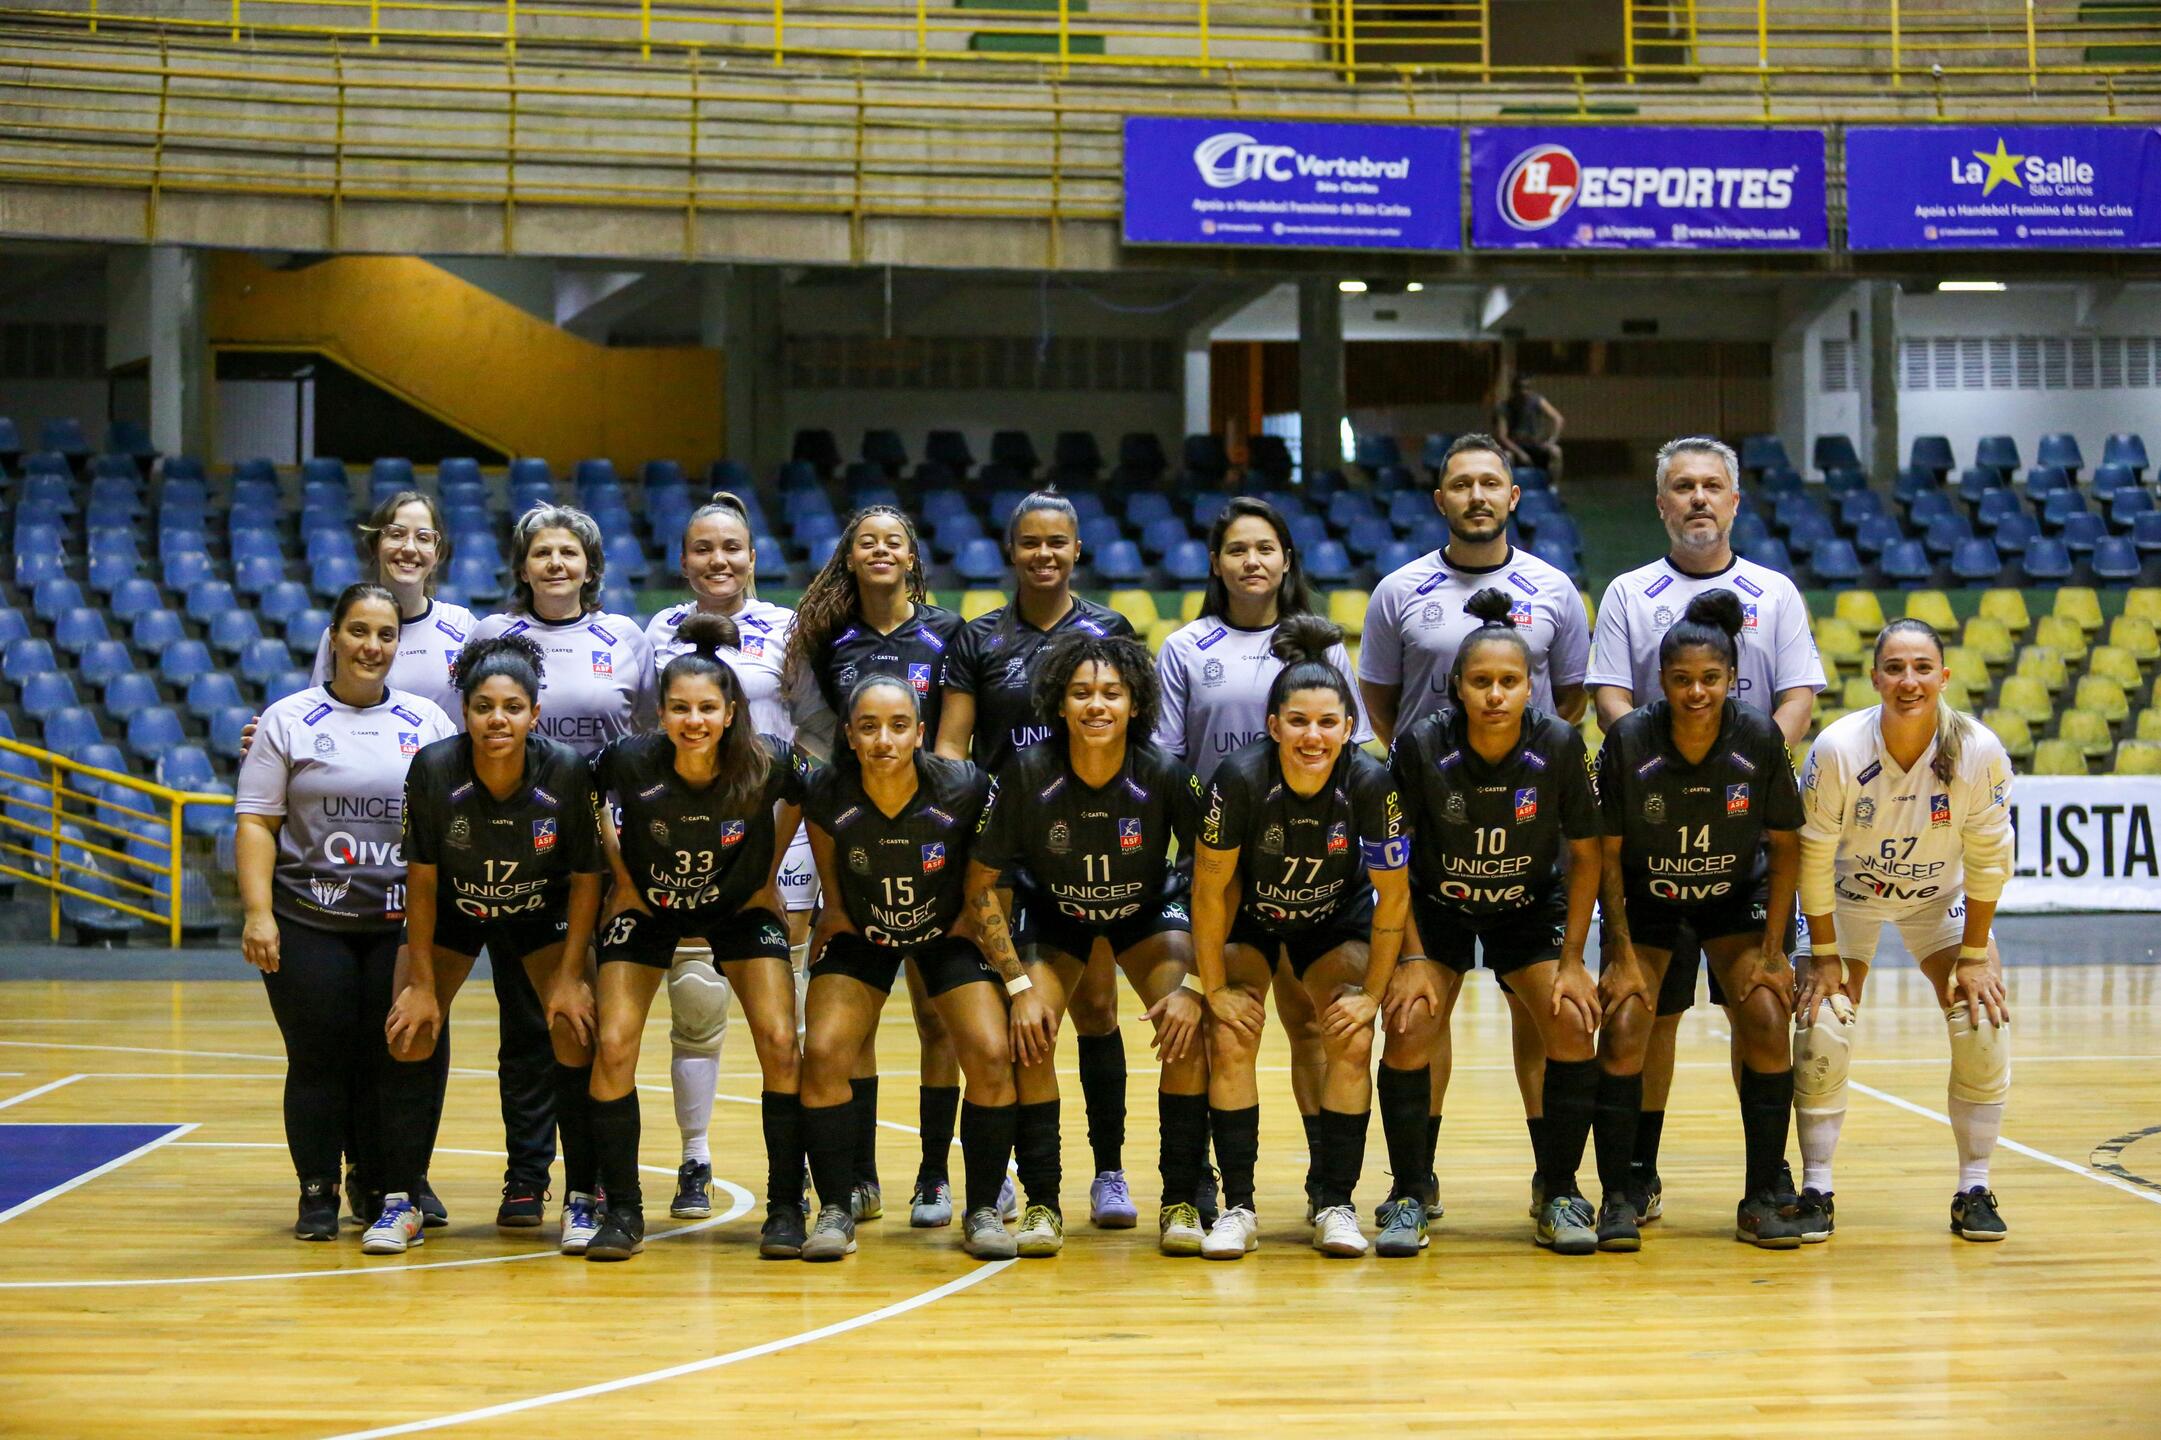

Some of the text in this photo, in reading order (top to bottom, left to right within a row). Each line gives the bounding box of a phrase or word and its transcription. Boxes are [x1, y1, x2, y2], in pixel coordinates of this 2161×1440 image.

[1296, 154, 1410, 180] Vertebral
[1951, 155, 2094, 184] La Salle
[1340, 182, 1380, 195] Carlos
[1576, 166, 1795, 209] ESPORTES
[2029, 183, 2094, 197] São Carlos
[1377, 203, 1412, 217] Carlos
[1915, 204, 1947, 218] Apoia
[1958, 204, 2010, 216] Handebol
[2011, 204, 2060, 217] Feminino
[2062, 205, 2076, 217] de
[2078, 204, 2097, 217] São
[2099, 205, 2134, 217] Carlos
[537, 716, 606, 738] NICEP
[1731, 751, 1756, 770] NORDEN
[323, 796, 405, 817] UNICE
[537, 836, 554, 846] ASF
[1124, 836, 1139, 846] ASF
[1474, 827, 1507, 855] 10
[1677, 824, 1711, 854] 14
[1880, 836, 1919, 860] 67
[675, 850, 714, 875] 33
[927, 859, 943, 869] ASF
[1383, 841, 1404, 867] C
[1442, 853, 1532, 875] UNICEP
[1648, 854, 1737, 872] UNICEP
[483, 859, 520, 883] 17
[650, 863, 723, 889] UNICE
[1083, 854, 1110, 882] 11
[1282, 856, 1324, 885] 77
[453, 877, 548, 898] UNICEP
[777, 873, 812, 887] NICEP
[881, 876, 915, 906] 15
[1051, 882, 1143, 899] UNICEP
[1256, 878, 1344, 901] UNICEP
[759, 936, 788, 947] UNICE
